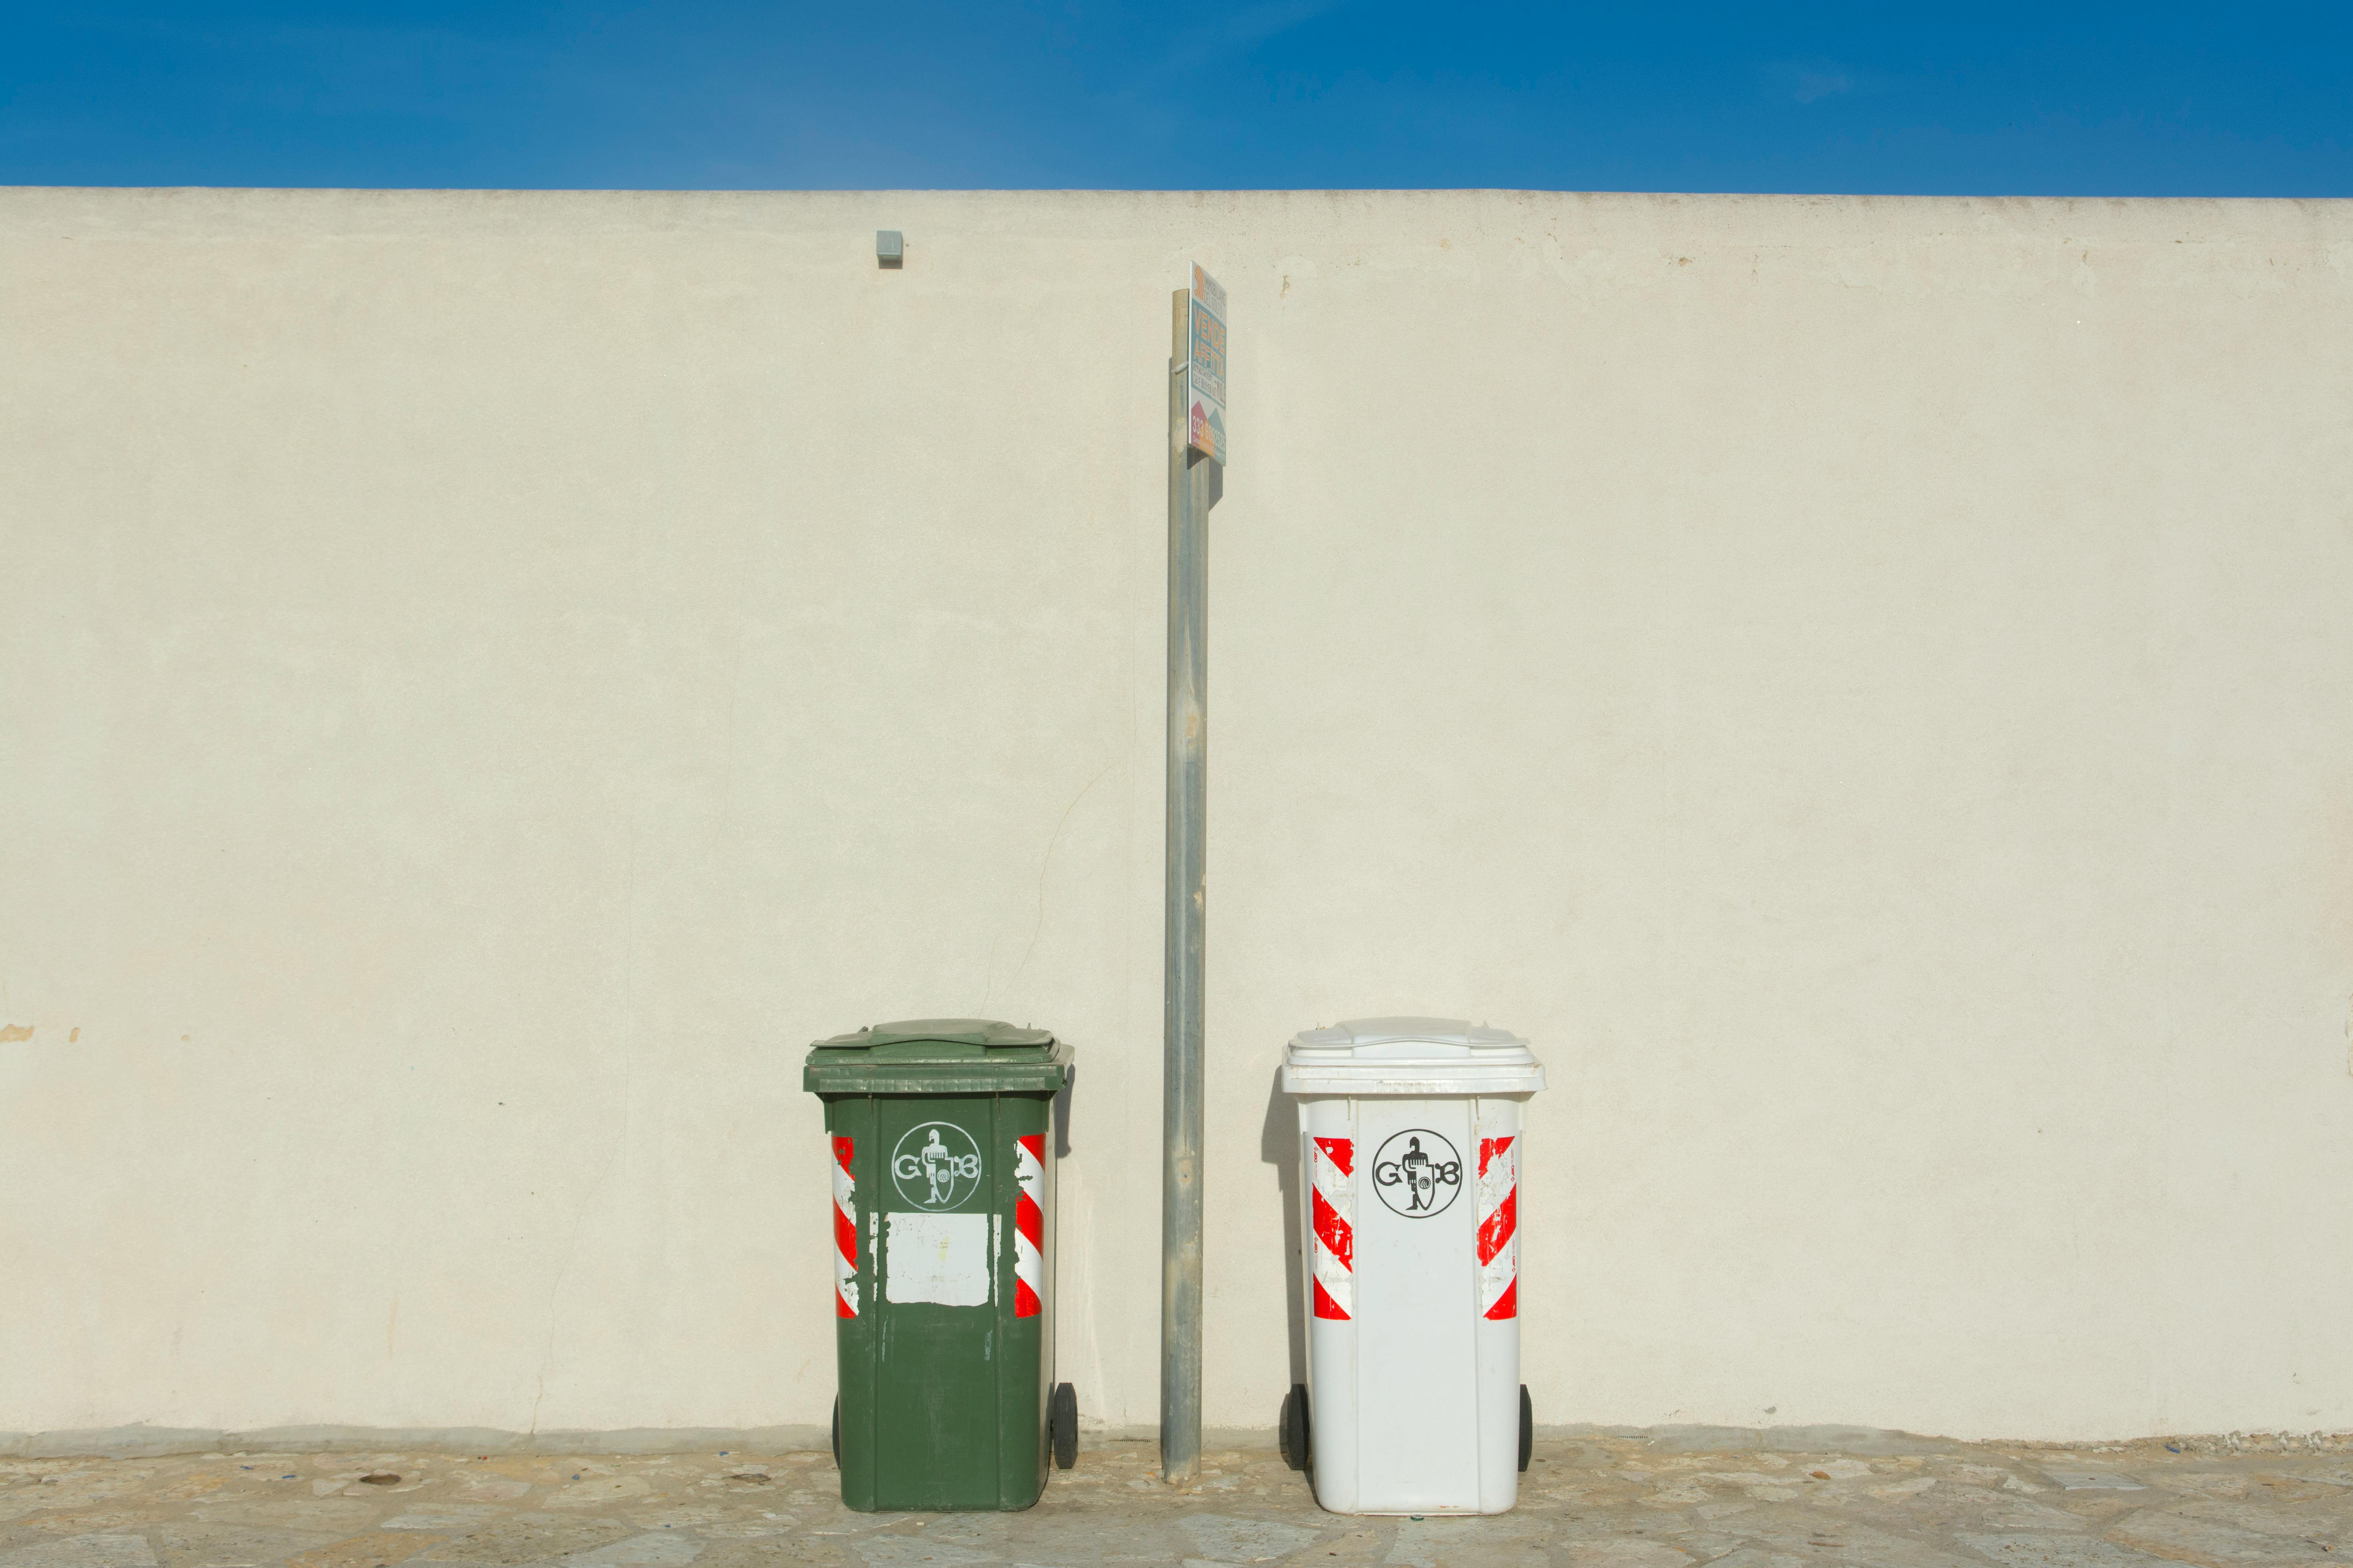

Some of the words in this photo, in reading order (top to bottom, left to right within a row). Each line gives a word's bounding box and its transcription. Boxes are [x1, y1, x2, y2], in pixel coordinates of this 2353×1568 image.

[1204, 275, 1225, 307] IMMOBILIARE
[1194, 305, 1225, 355] VENDE
[1194, 337, 1224, 381] AFFITTA
[1193, 415, 1203, 437] 333
[1205, 418, 1225, 452] 6092525
